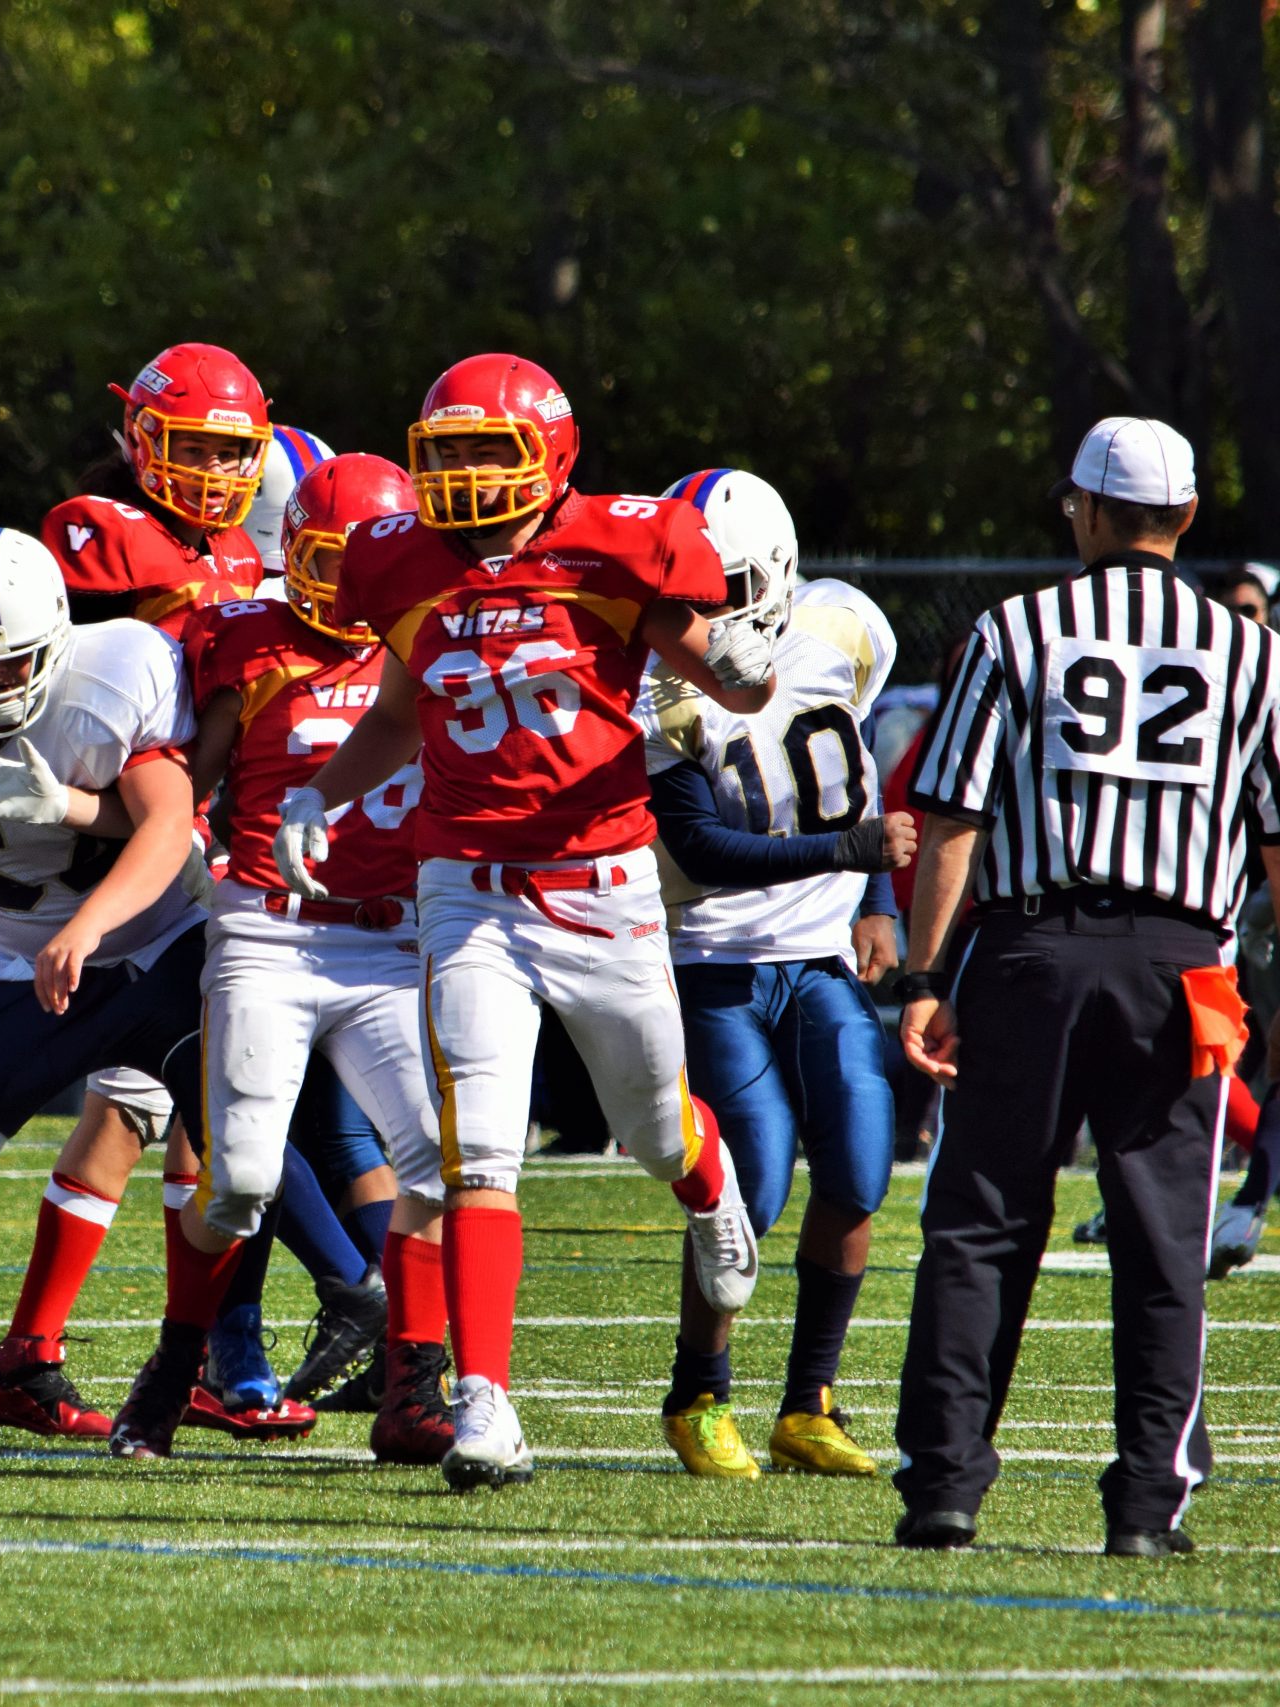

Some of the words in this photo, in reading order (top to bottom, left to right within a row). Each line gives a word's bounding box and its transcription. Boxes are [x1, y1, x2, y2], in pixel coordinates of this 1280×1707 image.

[422, 640, 582, 754] 96
[1060, 656, 1209, 767] 92
[721, 701, 868, 837] 10
